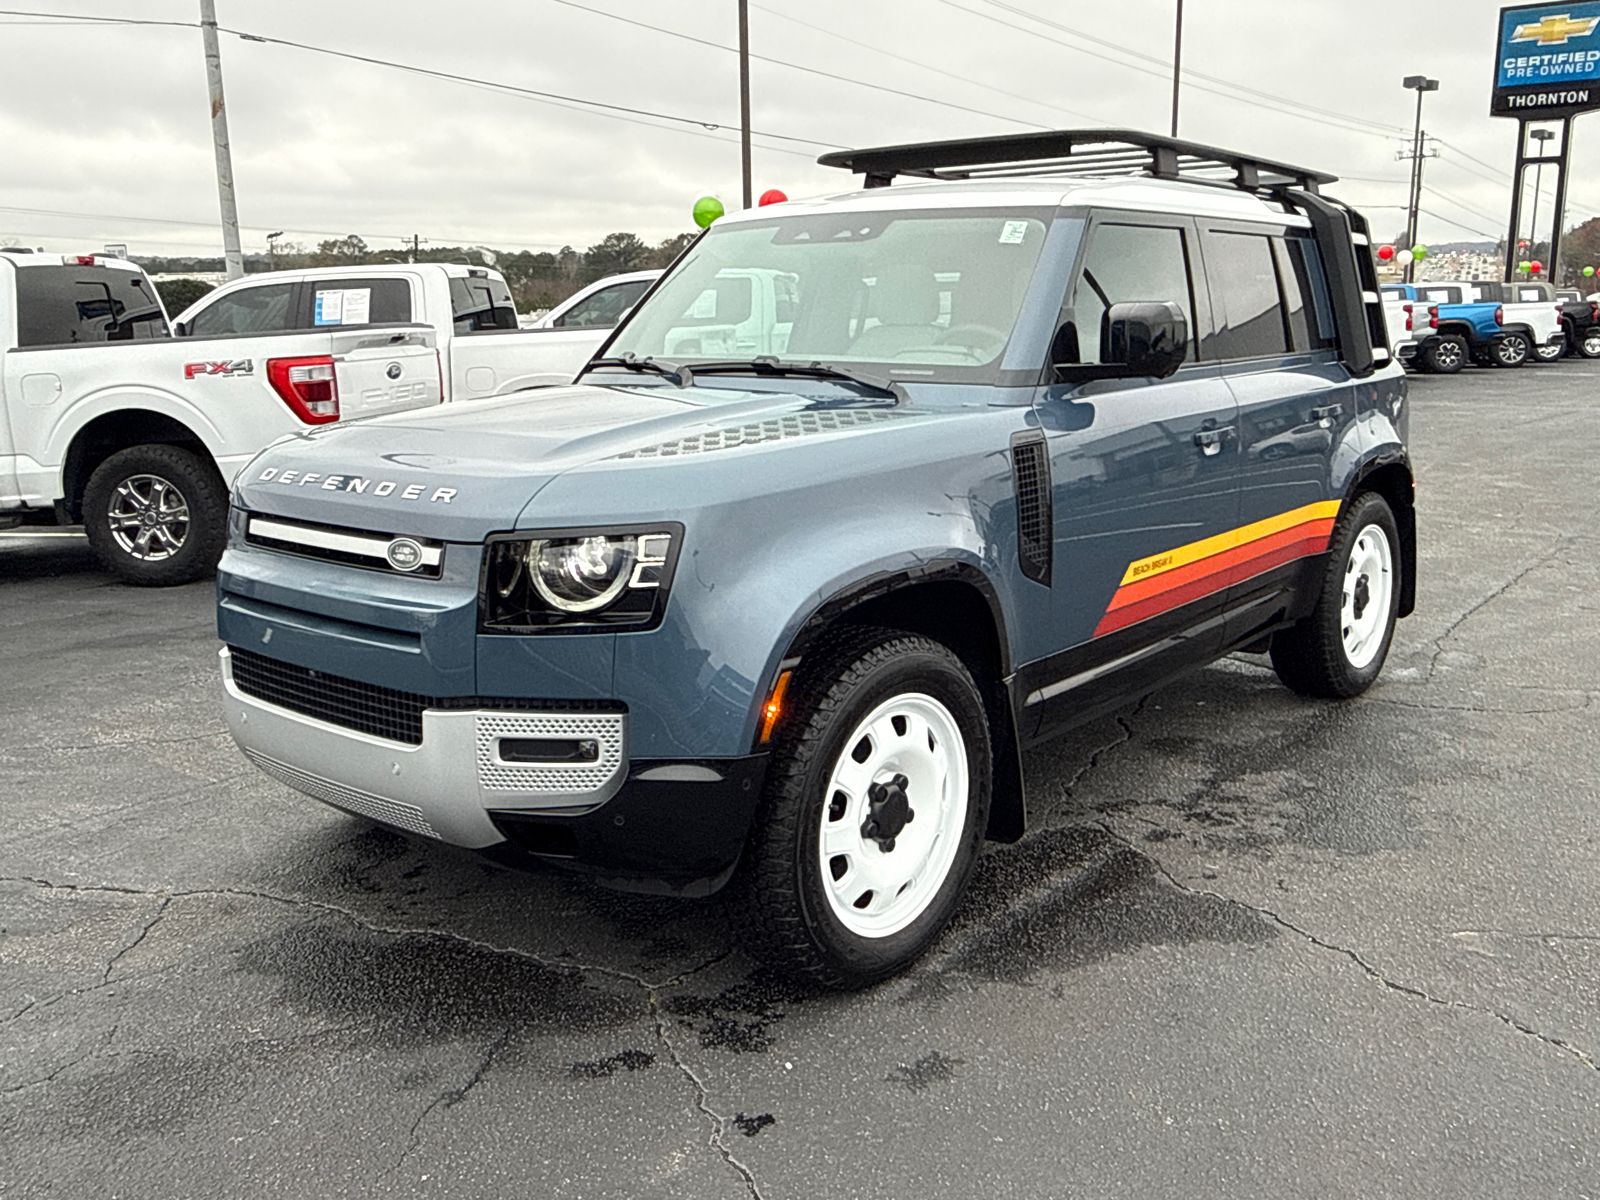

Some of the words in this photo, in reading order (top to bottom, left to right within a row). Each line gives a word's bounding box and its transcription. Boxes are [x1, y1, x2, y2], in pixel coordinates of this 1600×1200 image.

[1503, 50, 1600, 69] CERTIFIED
[1507, 62, 1594, 78] PRE-OWNED
[1507, 90, 1589, 107] THORNTON
[184, 359, 254, 379] FX4
[259, 467, 458, 503] DEFENDER
